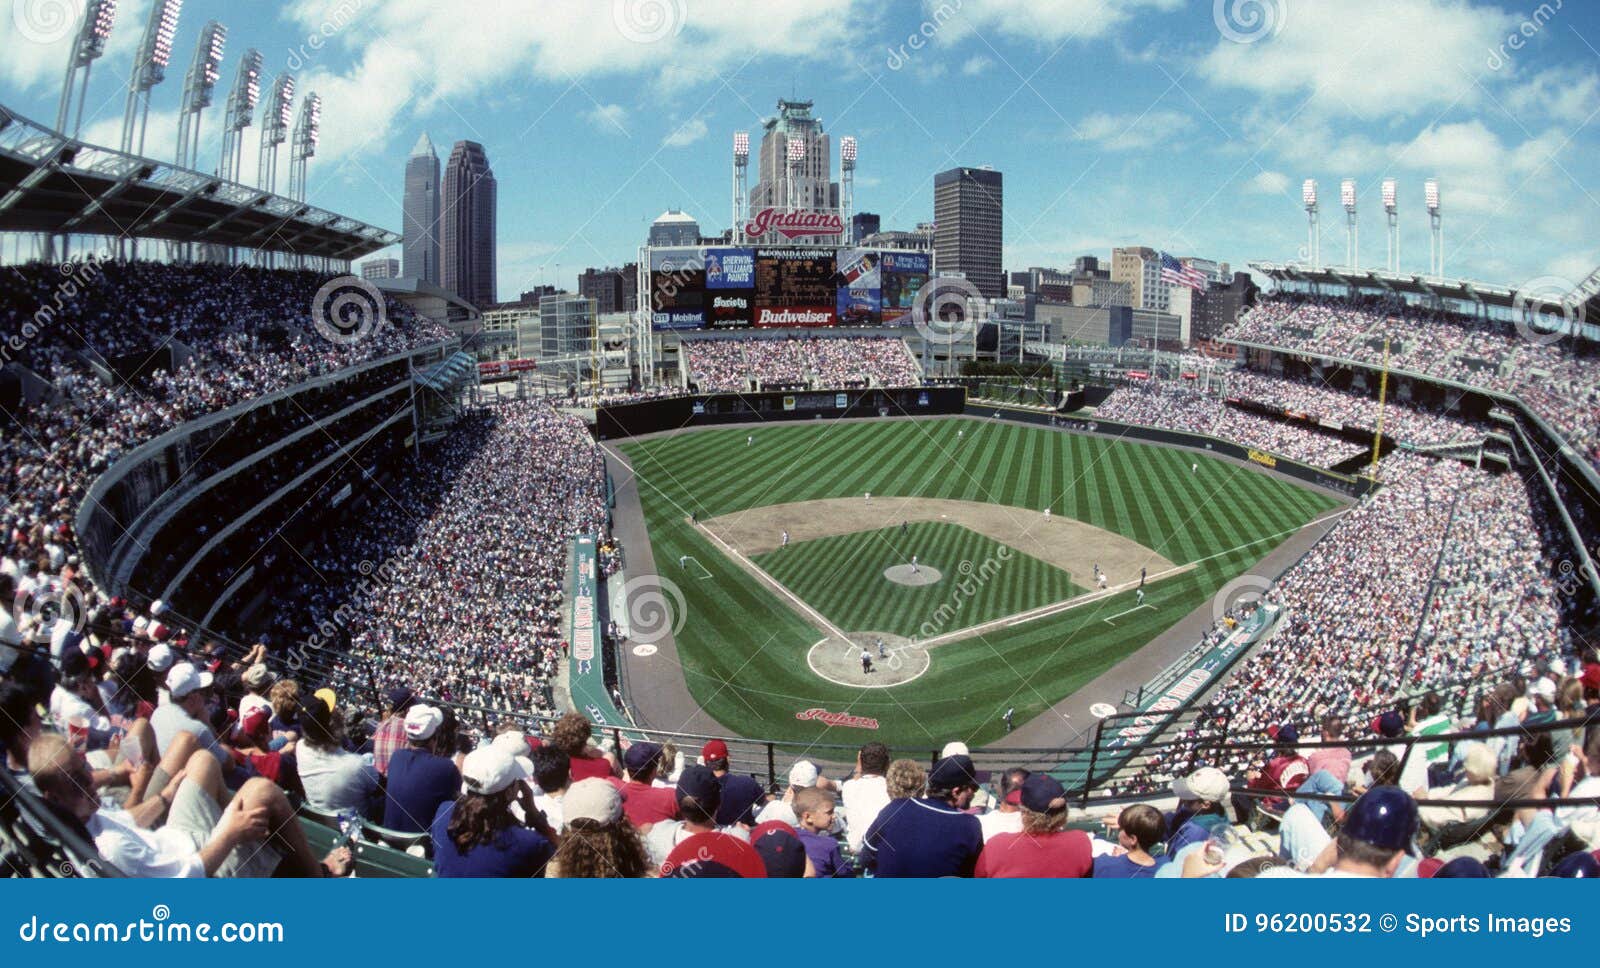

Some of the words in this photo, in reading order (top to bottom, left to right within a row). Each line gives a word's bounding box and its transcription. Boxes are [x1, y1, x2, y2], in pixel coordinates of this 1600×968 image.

[745, 208, 844, 239] Indians
[723, 264, 753, 273] WILLIAMS
[727, 273, 749, 282] PAINTS
[713, 296, 747, 309] Society
[758, 309, 832, 324] Budweiser
[795, 708, 880, 730] Indians
